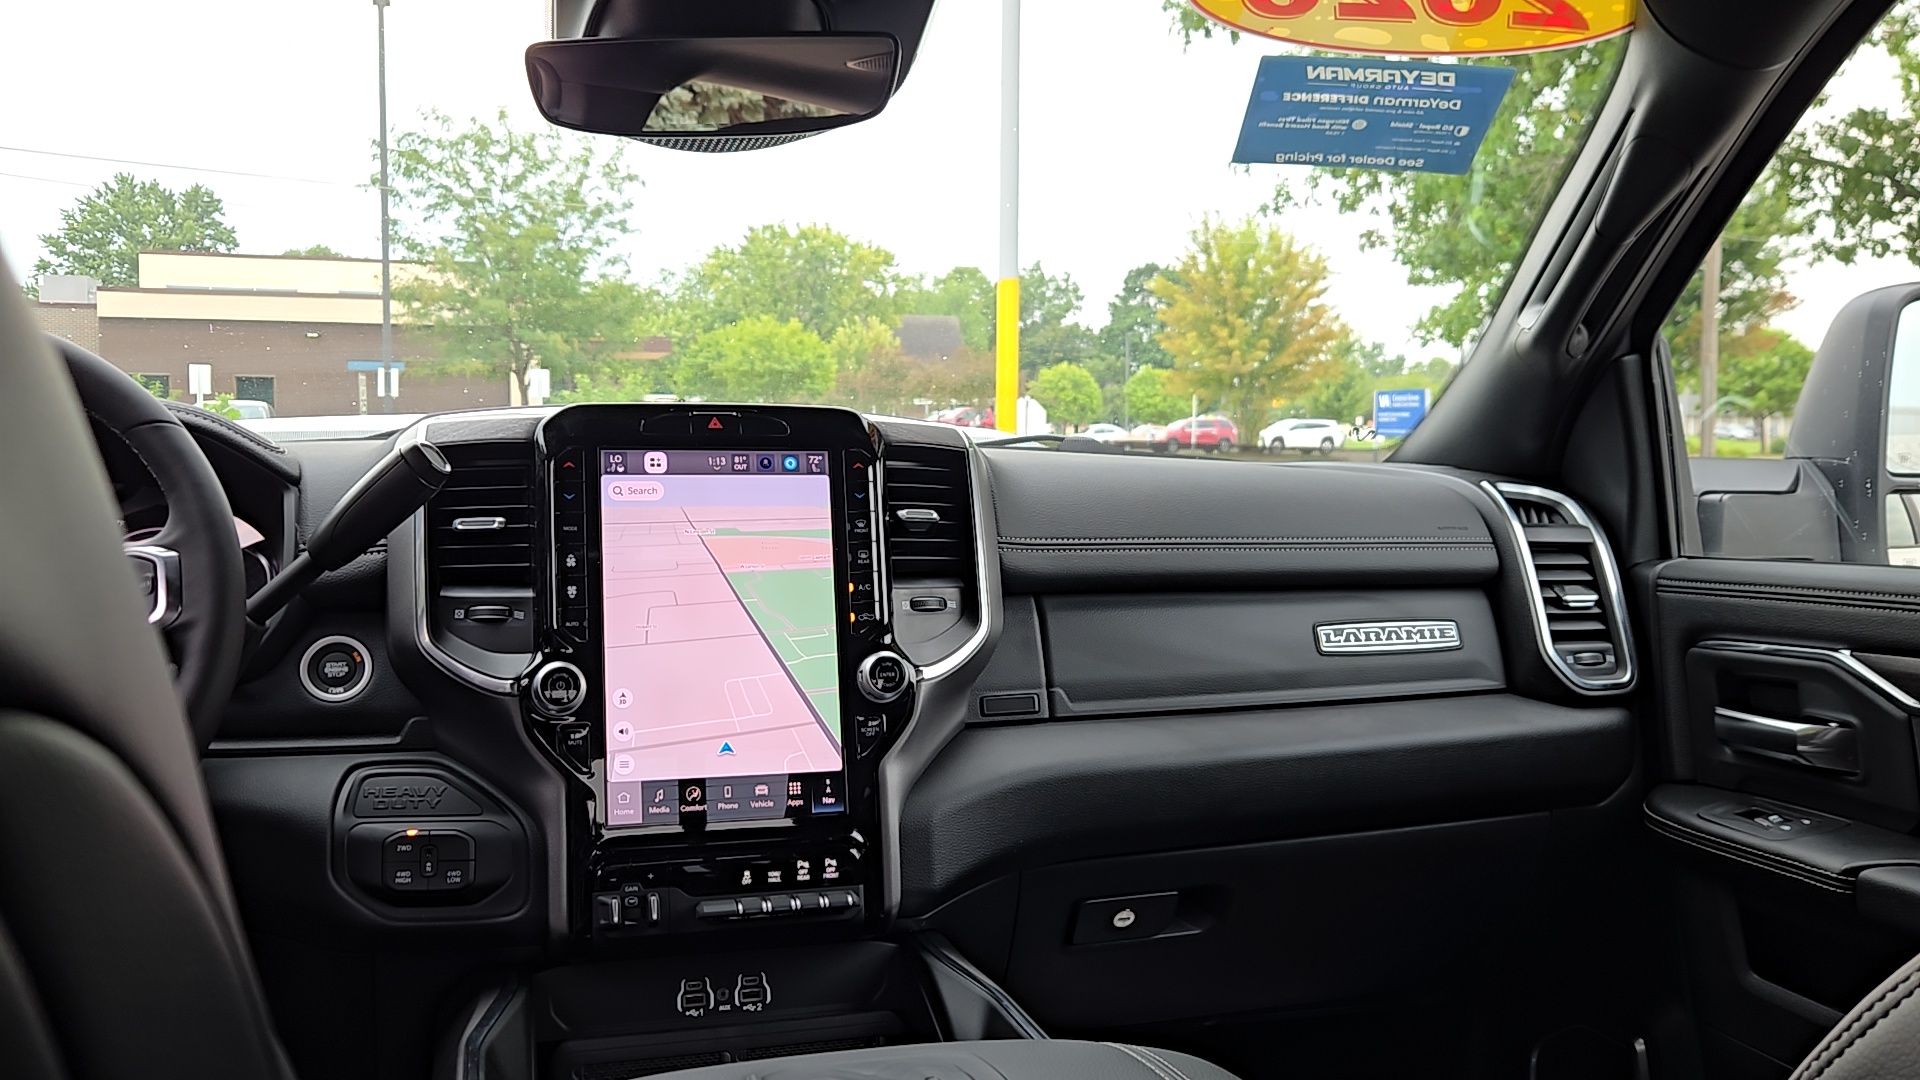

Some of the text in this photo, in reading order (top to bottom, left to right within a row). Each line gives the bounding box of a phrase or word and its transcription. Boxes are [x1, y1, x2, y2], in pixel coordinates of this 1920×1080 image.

[609, 454, 622, 463] LO
[708, 456, 726, 466] 1:13
[734, 455, 747, 463] 81°
[808, 455, 822, 464] 72°
[627, 486, 658, 495] Search
[858, 583, 872, 591] A/C
[1323, 627, 1456, 643] LARAMIE
[363, 785, 449, 798] HEAVY
[372, 798, 443, 810] DUTY
[750, 799, 775, 809] Vehicle
[787, 798, 804, 807] Apps
[822, 796, 836, 804] Nav
[648, 805, 671, 814] Media
[680, 804, 708, 812] Comfort
[717, 802, 739, 811] Phone
[613, 808, 635, 816] Home
[756, 1003, 763, 1011] 2
